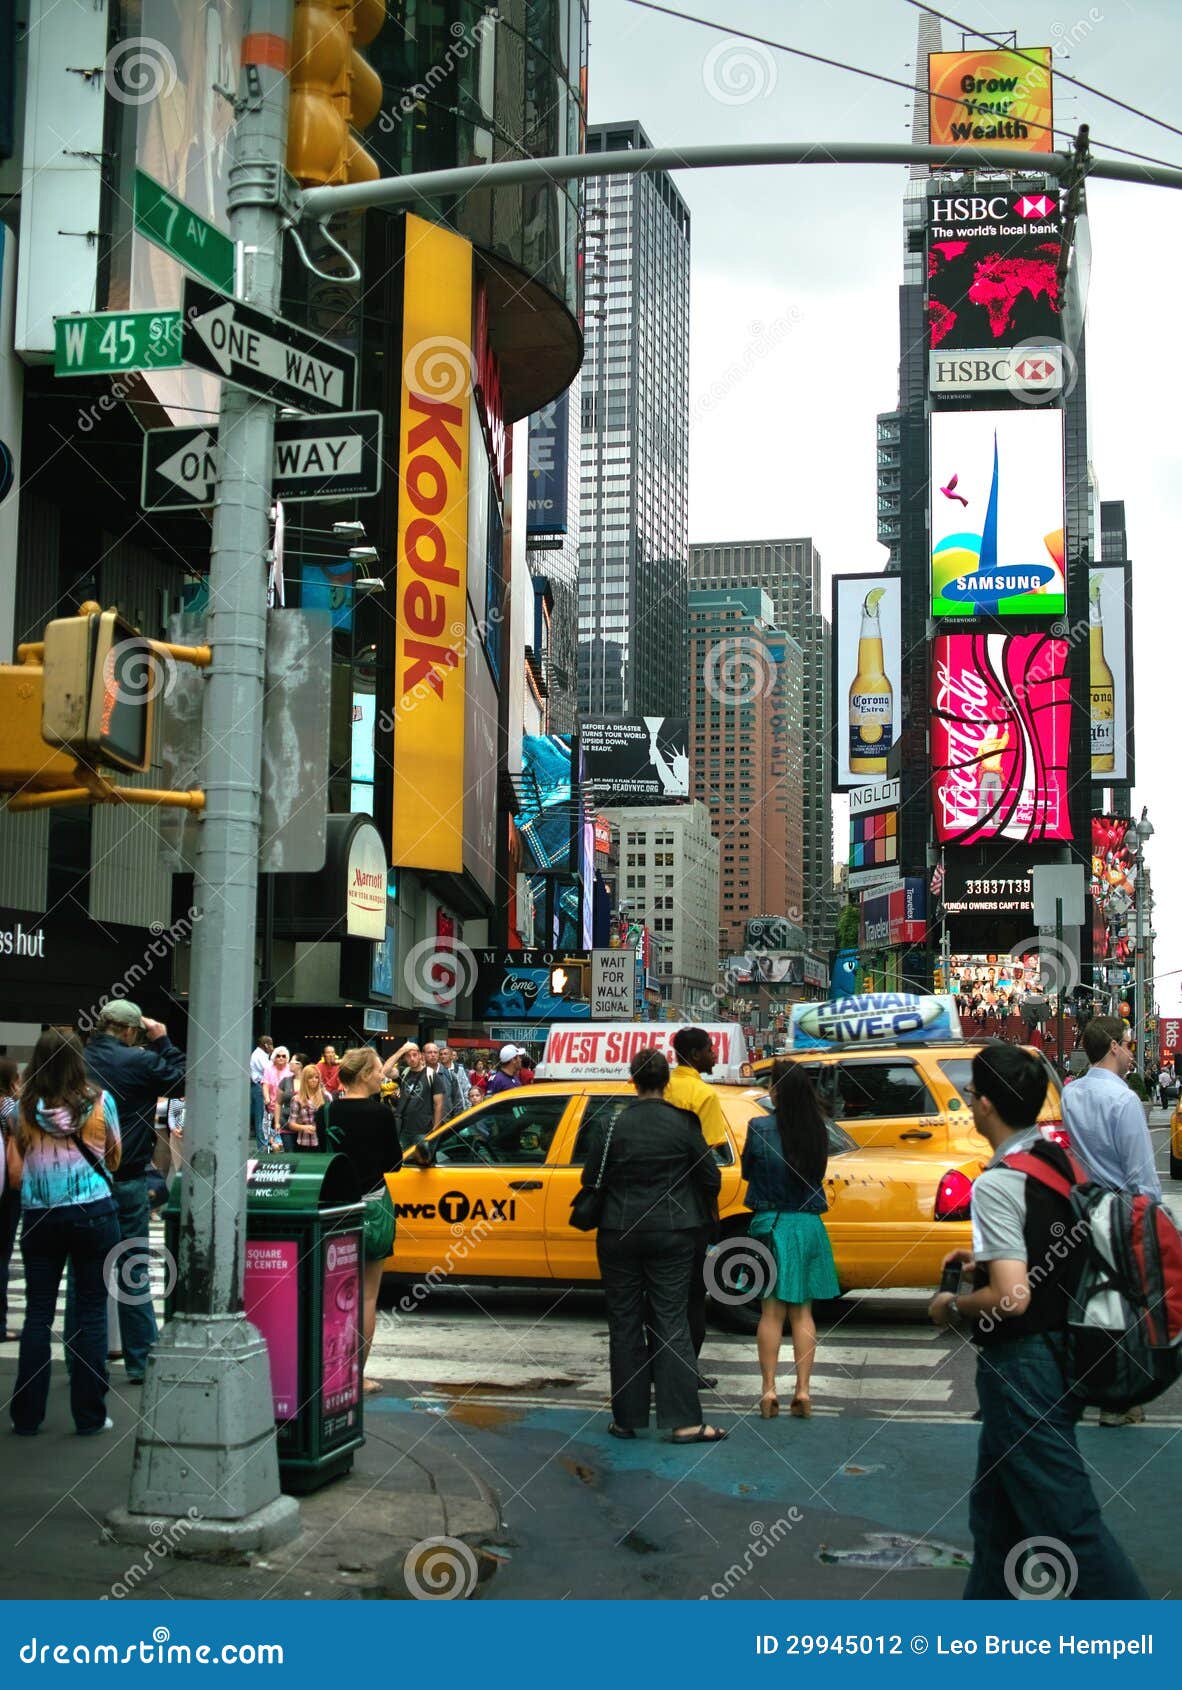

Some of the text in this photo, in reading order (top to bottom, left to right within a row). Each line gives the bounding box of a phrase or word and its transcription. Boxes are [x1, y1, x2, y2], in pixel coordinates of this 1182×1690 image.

[961, 75, 1018, 93] Grow
[963, 98, 1013, 115] Your
[950, 120, 1028, 141] Wealth
[931, 197, 1008, 222] HSBC
[160, 194, 207, 249] 7 AV
[931, 223, 1058, 238] The world's local bank
[64, 316, 174, 367] W 45 ST
[211, 318, 334, 396] ONE WAY
[936, 360, 1011, 382] HSBC
[180, 441, 348, 482] ON WAY
[528, 499, 554, 509] NYC
[402, 391, 463, 700] Kodak
[956, 576, 1041, 590] SAMSUNG
[852, 694, 889, 708] Corona
[612, 784, 659, 792] READYNYC.ORG
[850, 782, 900, 807] INGLOT
[353, 867, 383, 890] Marriott
[906, 888, 915, 919] Travelex
[943, 902, 968, 910] YUNDAI
[968, 902, 998, 910] OWNERS
[999, 902, 1020, 910] CAN'T
[600, 957, 627, 968] WAIT
[501, 973, 537, 997] Come
[602, 972, 624, 983] FOR
[597, 986, 628, 998] WALK
[595, 1001, 630, 1012] SIGNAL
[547, 1031, 606, 1064] WEST
[395, 1193, 516, 1222] NYC TAXI
[247, 1249, 282, 1259] SQUARE
[254, 1260, 288, 1270] CENTER
